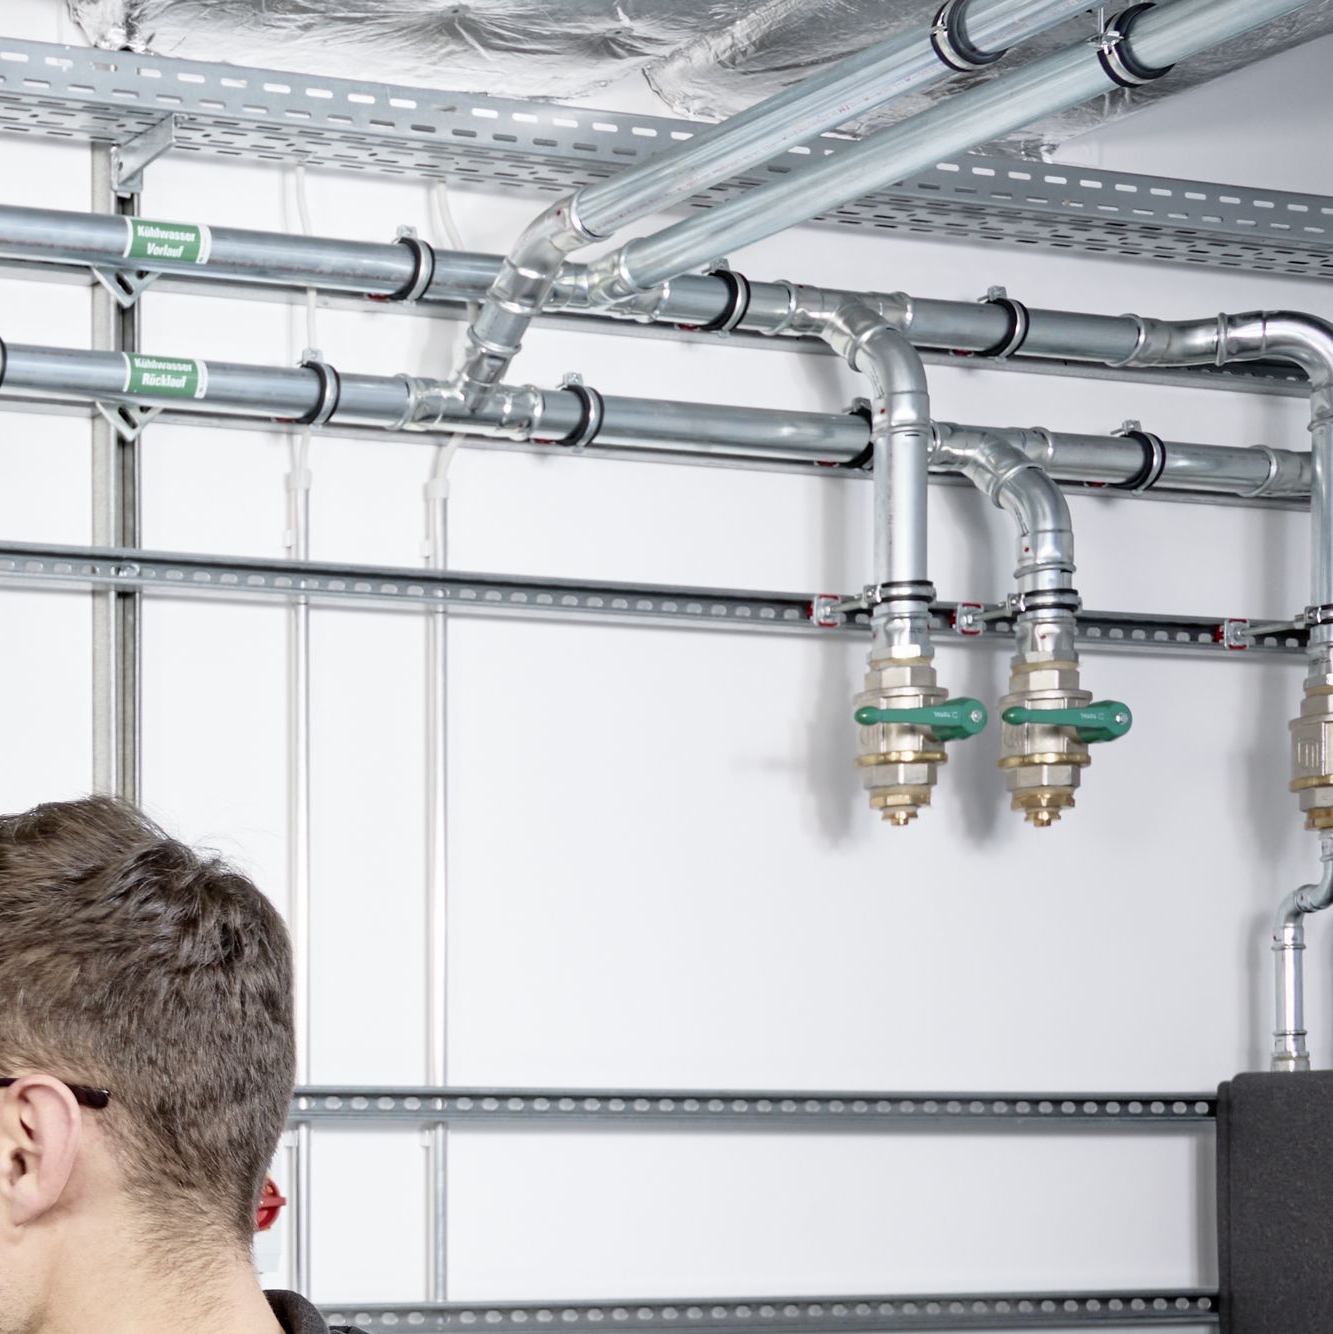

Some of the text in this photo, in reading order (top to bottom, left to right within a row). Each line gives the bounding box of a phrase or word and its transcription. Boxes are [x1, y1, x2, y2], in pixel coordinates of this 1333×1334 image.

[137, 225, 196, 242] Kühlwasser
[146, 242, 184, 258] Vorlauf
[134, 358, 193, 372] Kühlwasser
[142, 373, 187, 388] Rücklauf
